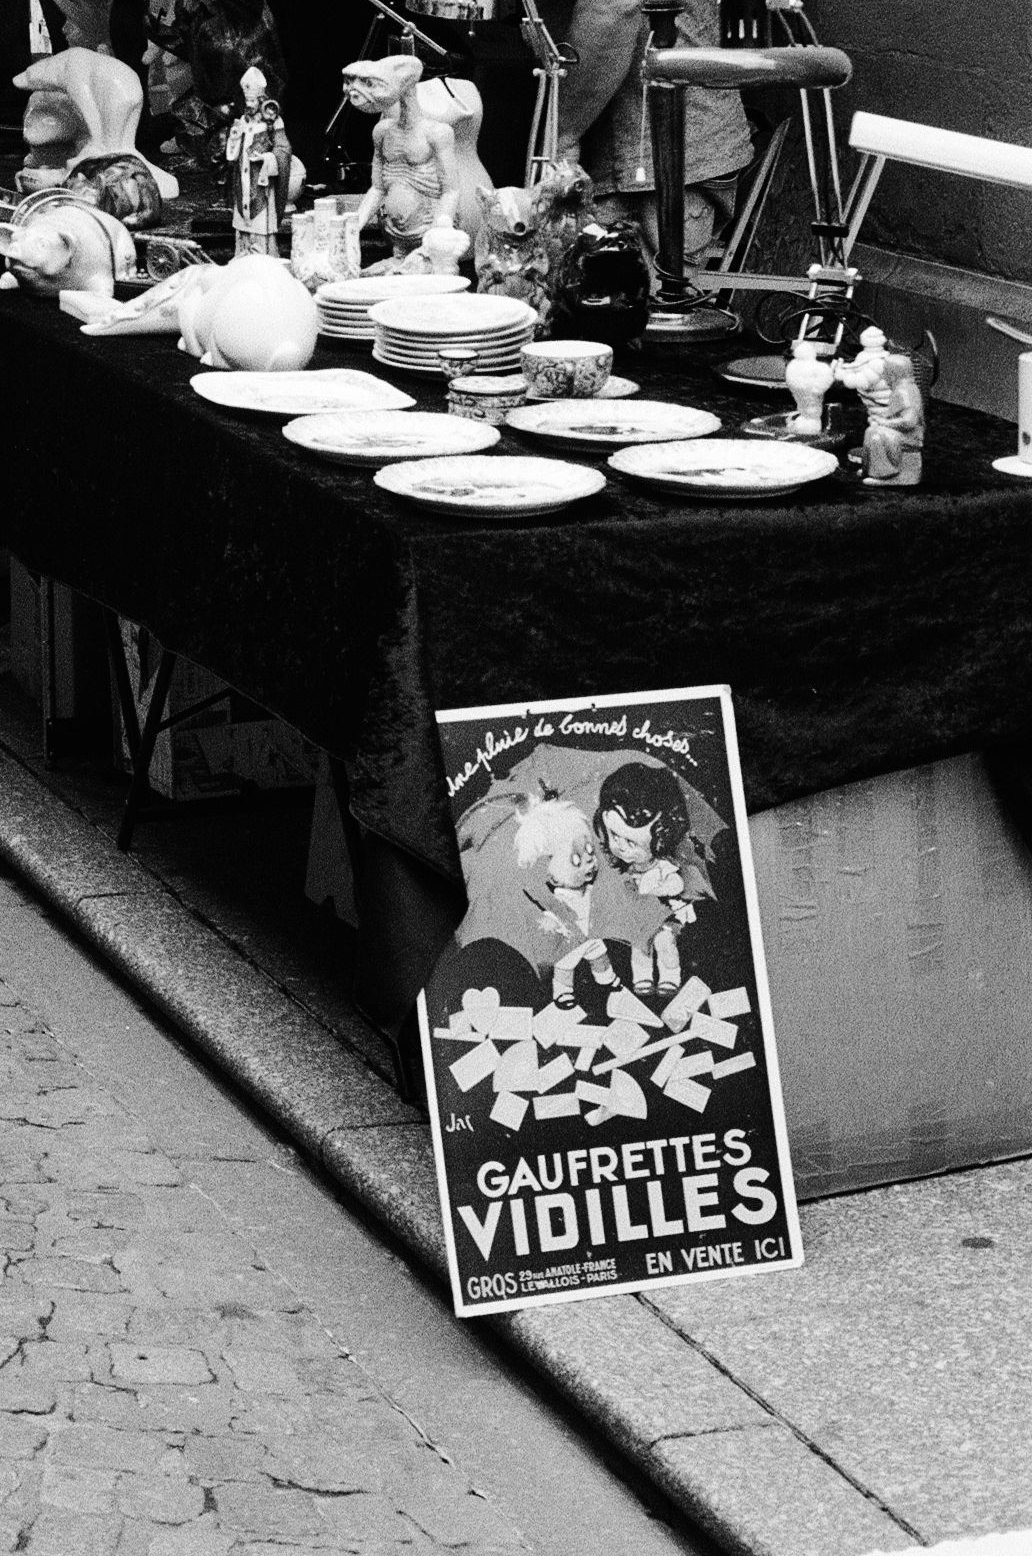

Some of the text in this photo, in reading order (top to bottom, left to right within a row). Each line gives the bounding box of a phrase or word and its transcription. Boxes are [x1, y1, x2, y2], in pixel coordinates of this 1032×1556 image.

[534, 717, 554, 737] de
[558, 713, 628, 736] bonnes
[476, 1128, 752, 1199] GAUFRETTES
[457, 1166, 778, 1262] VIDILLES
[646, 1236, 785, 1276] EN VENTE ICI
[467, 1272, 518, 1301] GROS
[519, 1269, 534, 1282] 29
